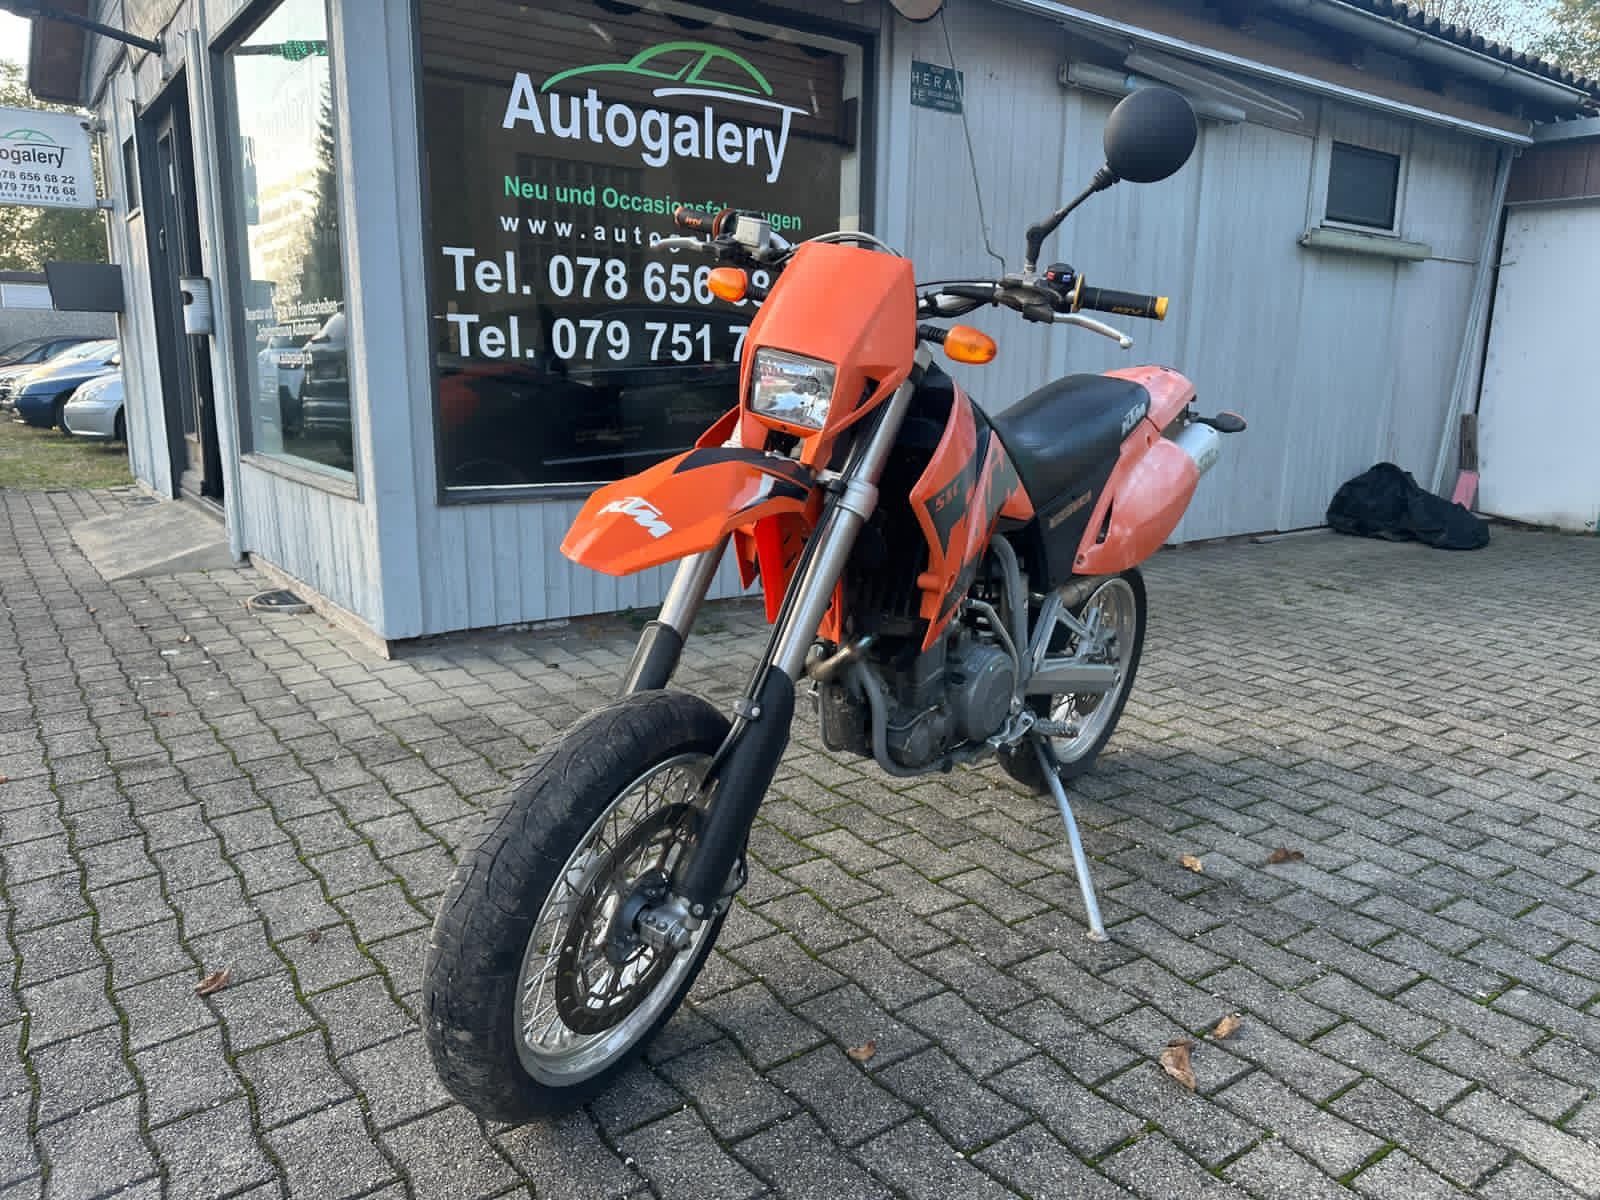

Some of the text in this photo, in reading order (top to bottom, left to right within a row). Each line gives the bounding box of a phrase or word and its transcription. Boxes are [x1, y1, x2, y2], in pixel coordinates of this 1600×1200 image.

[502, 71, 792, 184] Autogalery
[0, 170, 75, 185] 78 656 68 22
[0, 182, 17, 192] 79
[21, 183, 41, 193] 751
[504, 175, 548, 201] Neu
[555, 186, 596, 208] und
[442, 246, 532, 295] Tel.
[549, 255, 628, 300] 078
[643, 262, 715, 305] 656
[446, 313, 535, 359] Tel.
[552, 317, 630, 361] 079
[644, 321, 711, 363] 751
[595, 495, 673, 538] KTM
